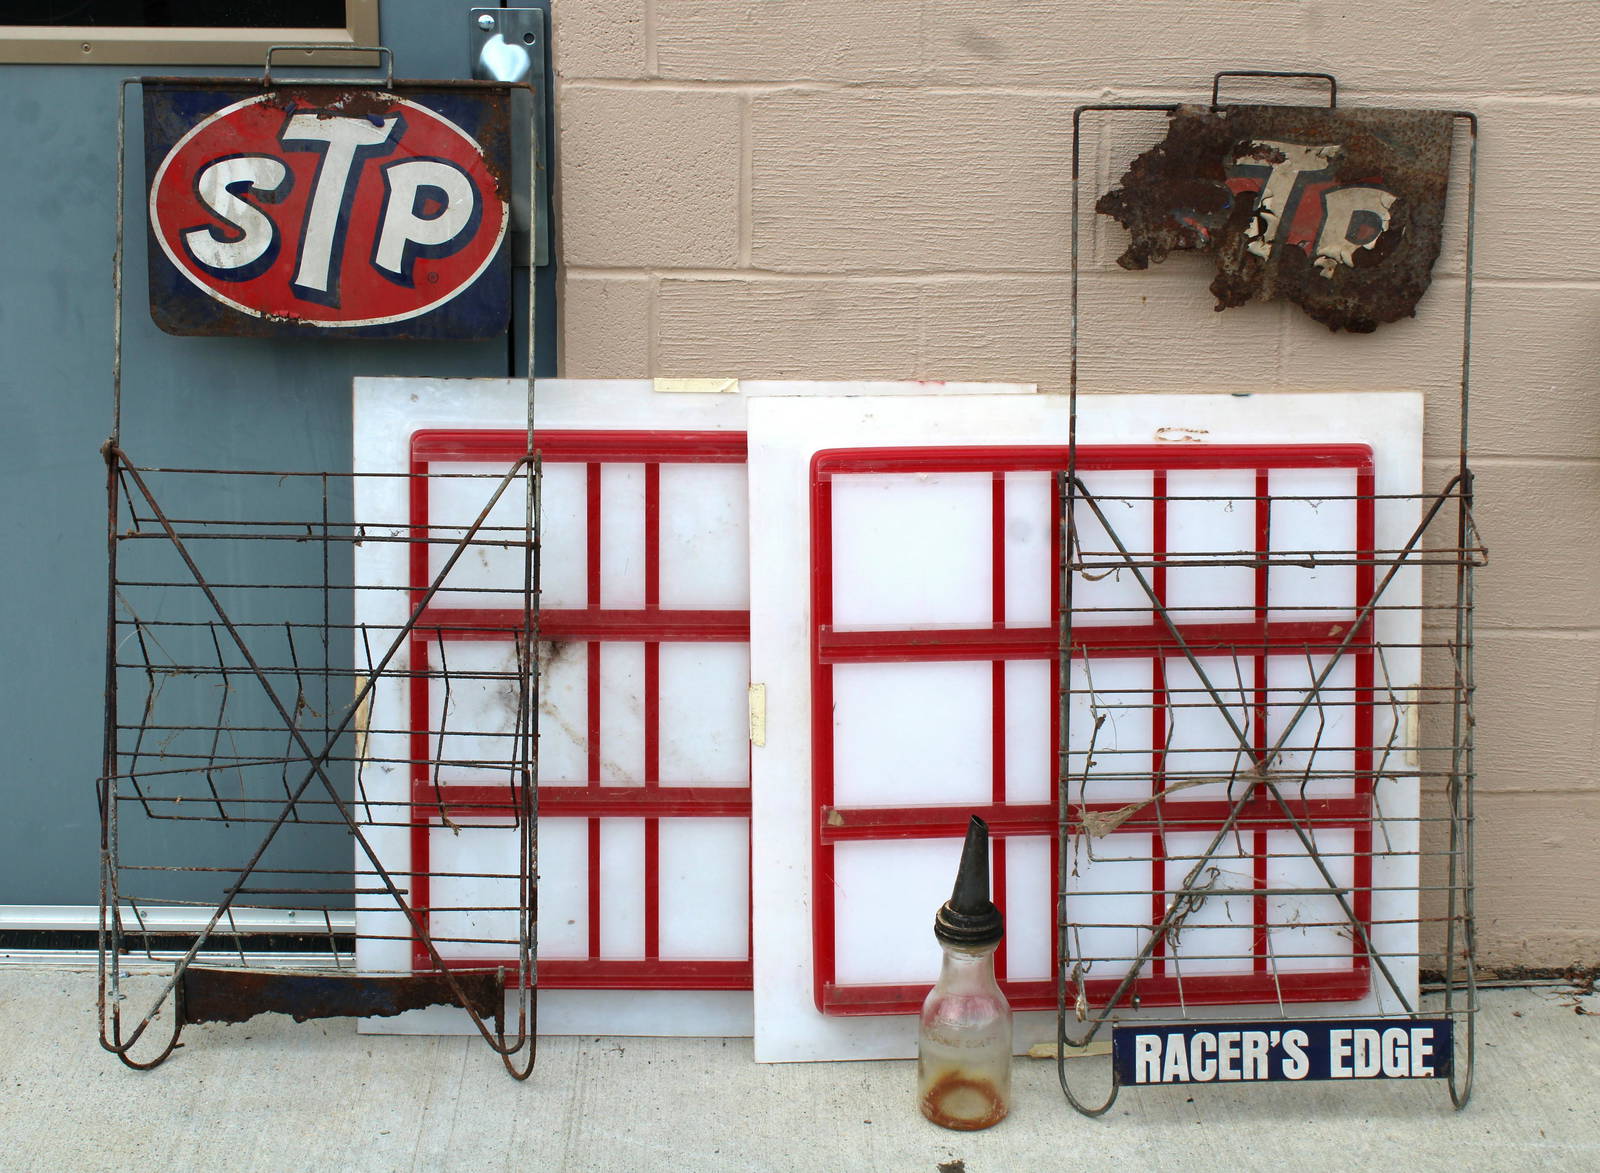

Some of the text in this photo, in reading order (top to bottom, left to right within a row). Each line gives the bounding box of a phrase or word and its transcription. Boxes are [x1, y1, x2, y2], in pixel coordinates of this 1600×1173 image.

[183, 110, 479, 302] STP
[1172, 140, 1400, 280] TP
[1135, 1027, 1435, 1083] RACER'S EDGE
